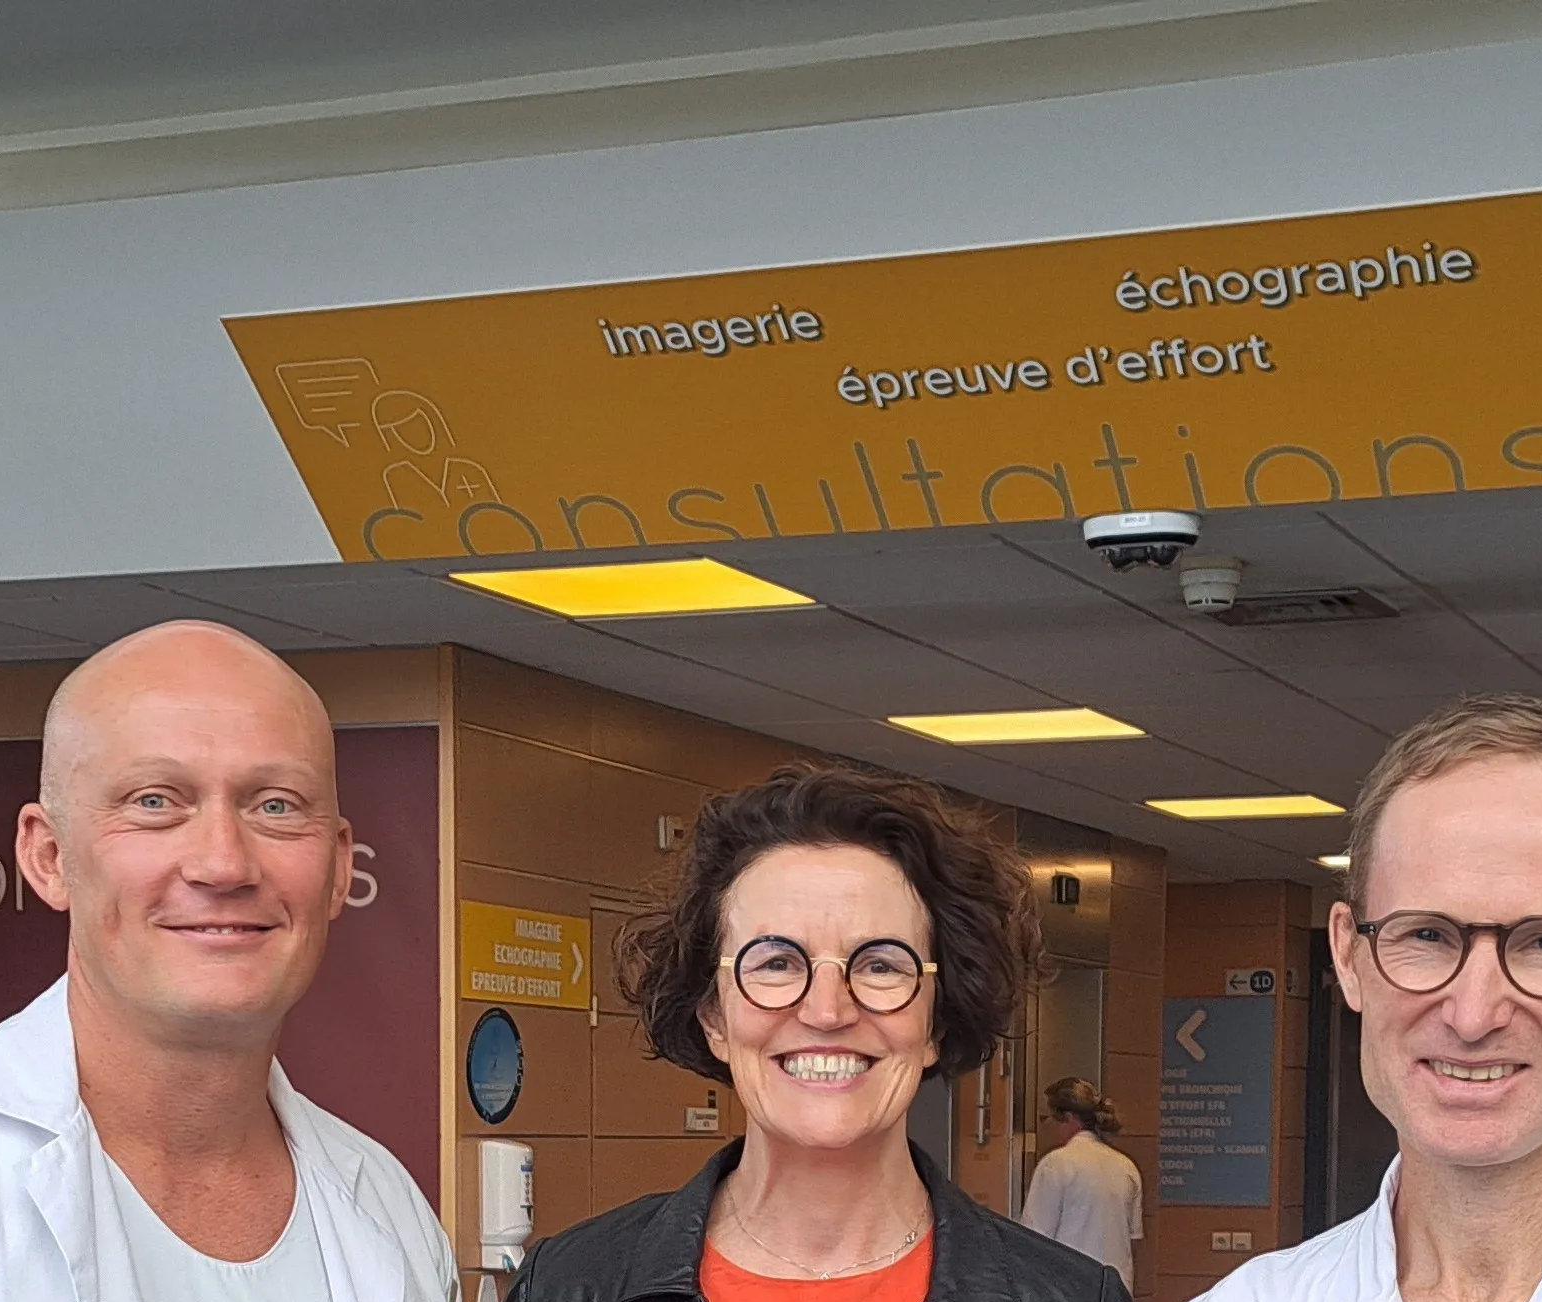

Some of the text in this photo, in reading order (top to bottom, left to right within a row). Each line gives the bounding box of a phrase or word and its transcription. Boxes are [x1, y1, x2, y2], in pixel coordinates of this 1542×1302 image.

[1114, 239, 1475, 316] échographie
[599, 301, 823, 358] imagerie
[837, 358, 1049, 409] épreuve
[514, 917, 563, 943] IMAGERIE
